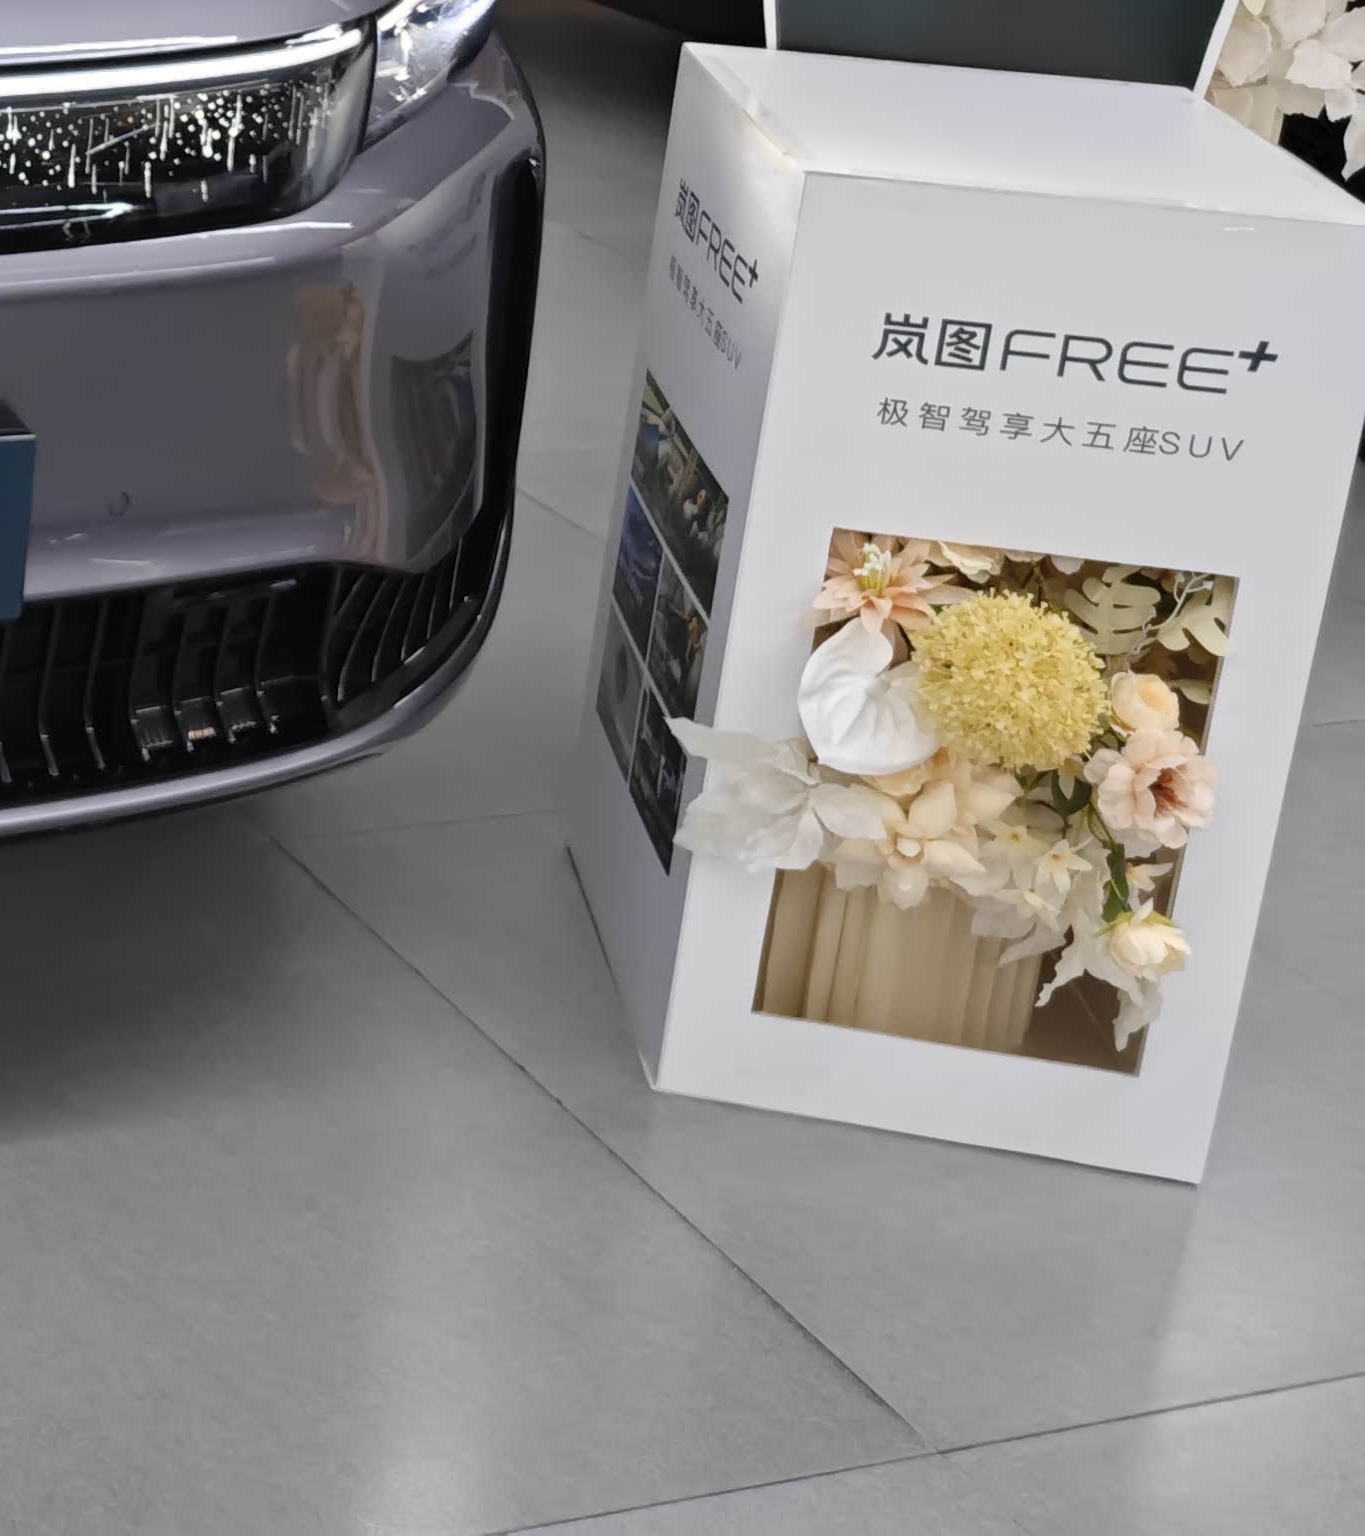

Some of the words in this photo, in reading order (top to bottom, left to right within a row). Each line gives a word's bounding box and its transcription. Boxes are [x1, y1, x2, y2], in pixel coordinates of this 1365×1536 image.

[871, 311, 1279, 395] 岚图FREE+
[876, 397, 1245, 463] 极智驾享大五座SUV
